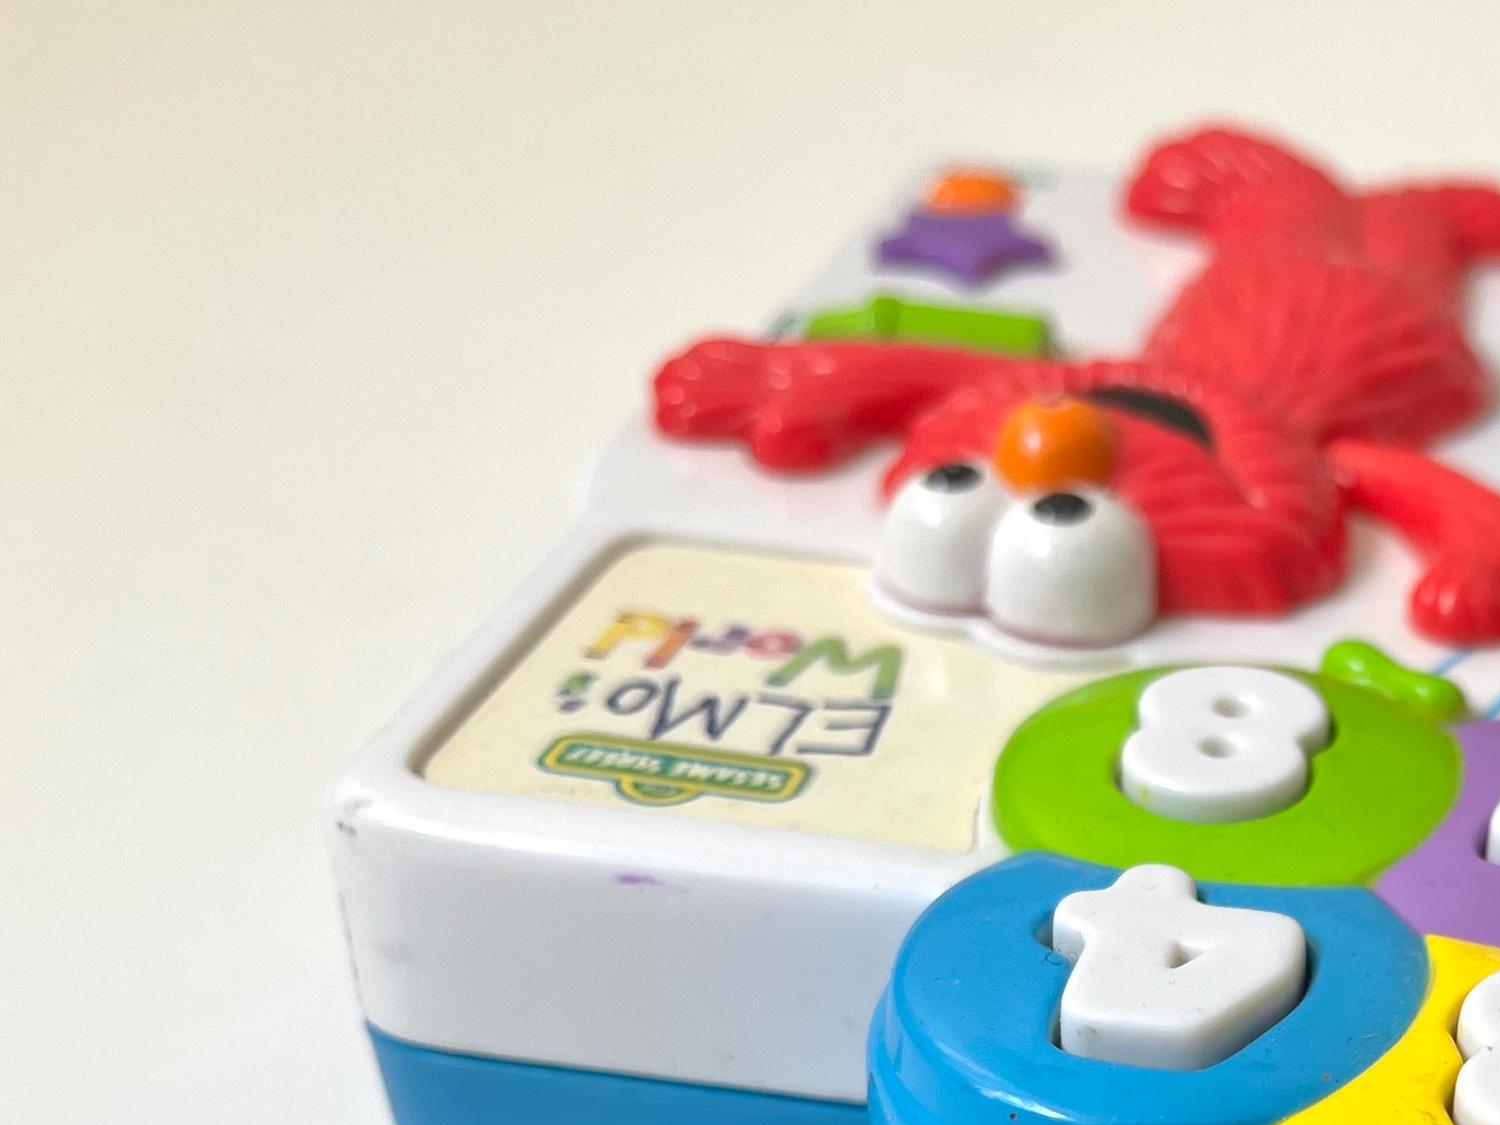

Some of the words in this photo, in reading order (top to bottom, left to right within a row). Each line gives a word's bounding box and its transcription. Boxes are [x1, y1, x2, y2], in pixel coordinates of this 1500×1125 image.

[582, 607, 905, 702] World
[564, 742, 662, 777] STREET
[668, 759, 788, 792] SESAME
[1120, 666, 1331, 823] 8
[1053, 863, 1307, 1071] 4
